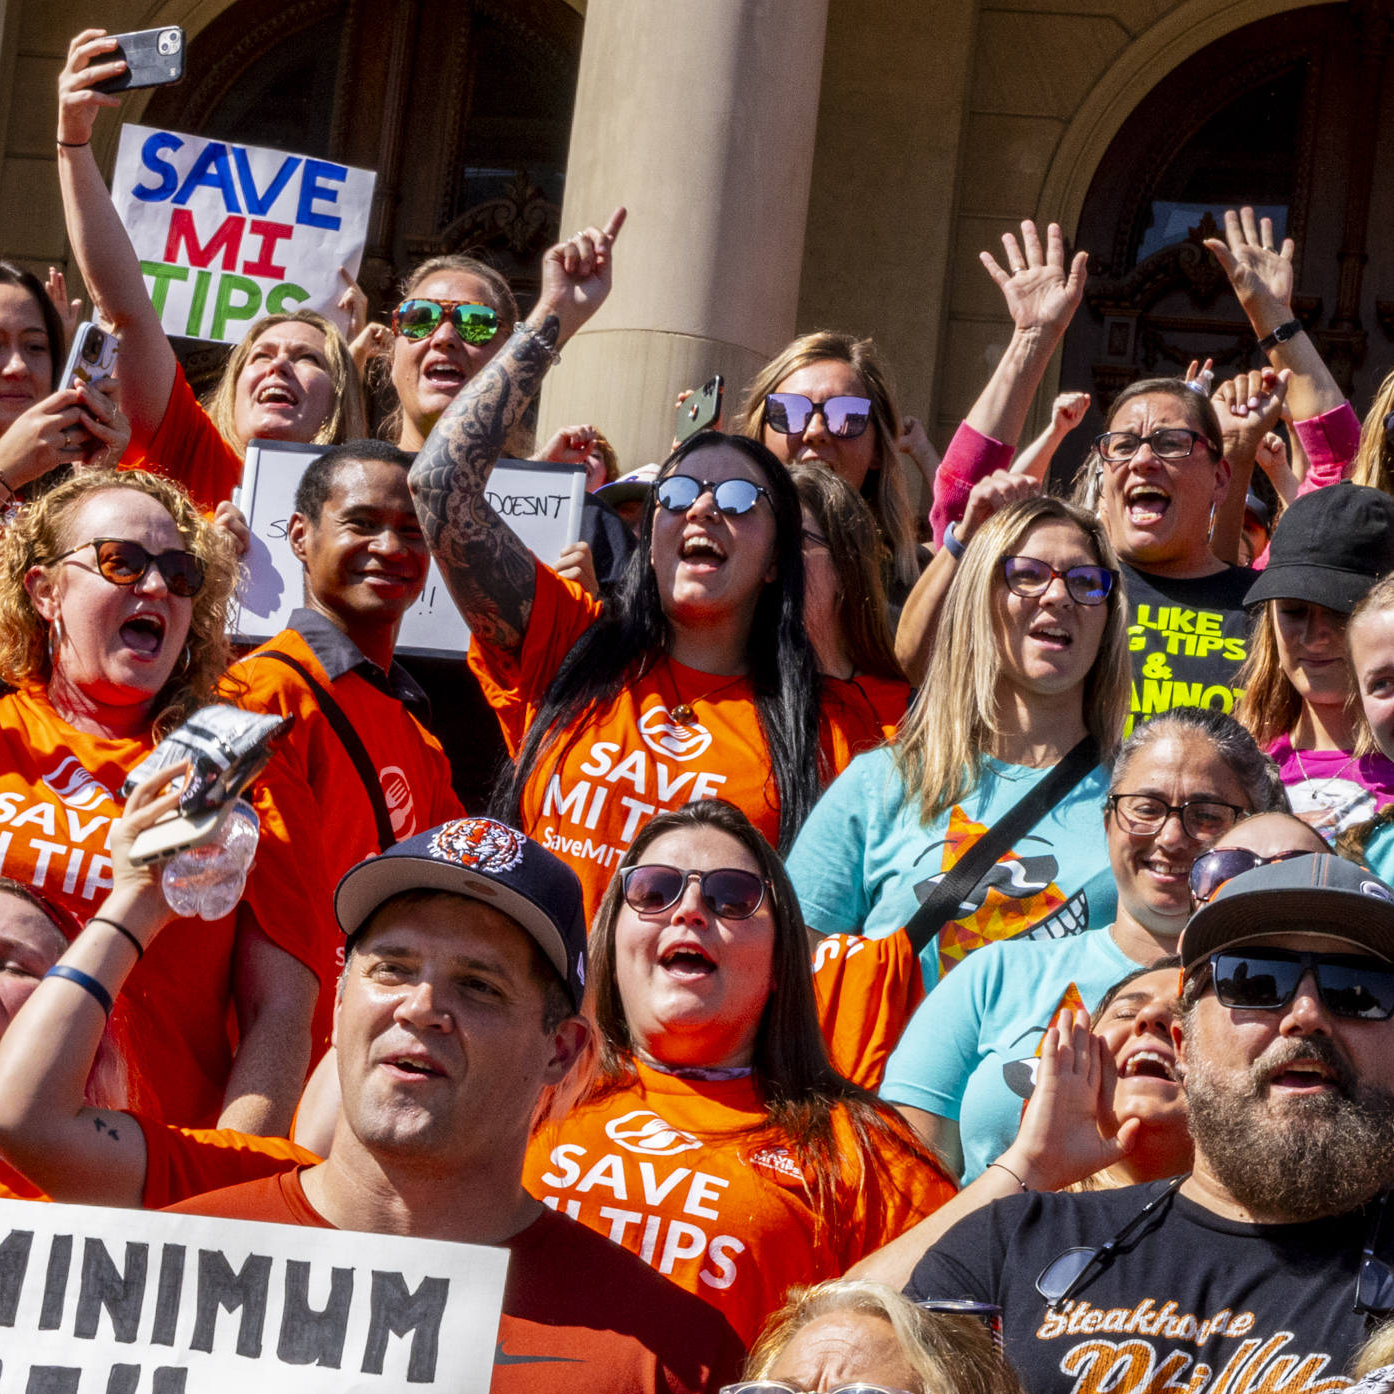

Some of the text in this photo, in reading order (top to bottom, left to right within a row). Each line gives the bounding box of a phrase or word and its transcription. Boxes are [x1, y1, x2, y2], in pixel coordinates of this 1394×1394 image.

[131, 131, 348, 232] SAVE
[163, 208, 294, 280] MI
[1137, 604, 1224, 637] LIKE
[1161, 630, 1247, 660] TIPS
[1142, 651, 1173, 680] &
[542, 774, 608, 830] MI
[541, 1143, 730, 1221] SAVE
[599, 1206, 745, 1290] TIPS
